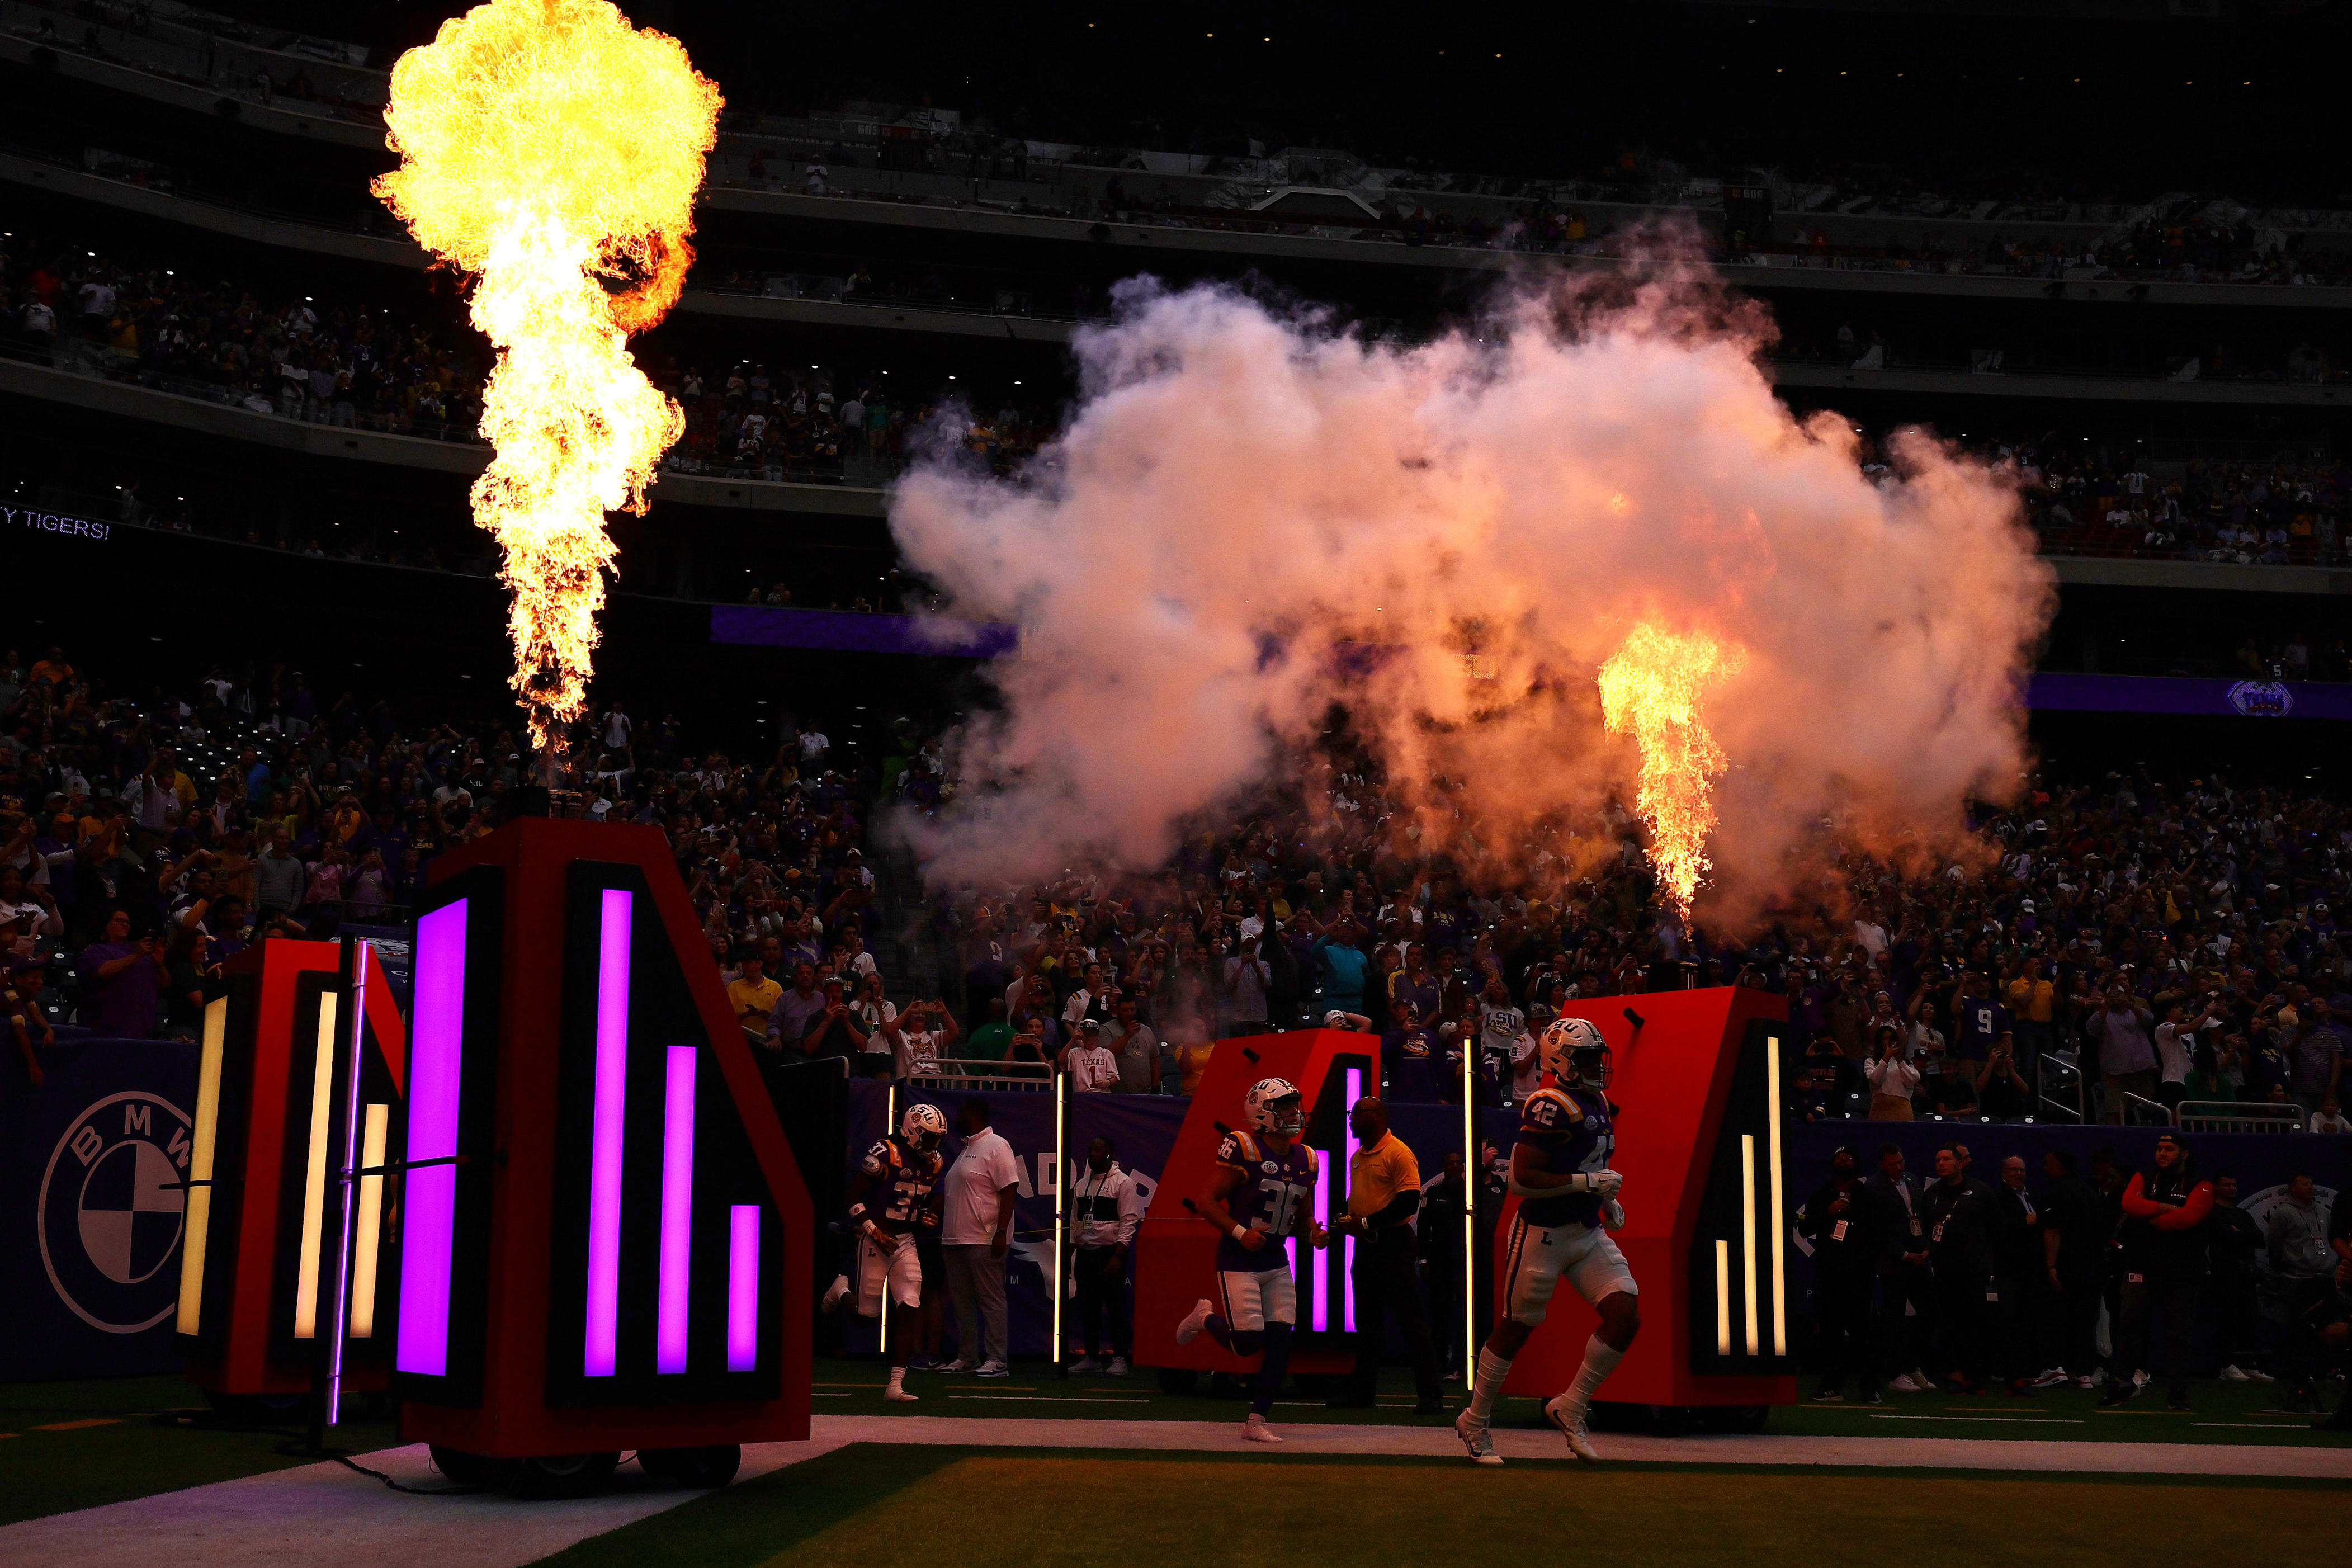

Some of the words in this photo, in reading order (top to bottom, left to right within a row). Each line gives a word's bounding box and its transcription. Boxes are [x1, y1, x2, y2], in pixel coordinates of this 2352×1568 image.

[0, 506, 17, 524] Y
[23, 510, 110, 541] TIGERS!
[2273, 664, 2282, 677] 5
[1485, 1012, 1517, 1029] LSU
[1978, 1008, 1992, 1034] 9
[1512, 1047, 1517, 1056] 9
[1088, 1066, 1098, 1088] 1
[1531, 1100, 1558, 1126] 42
[70, 1104, 193, 1170] BMW
[1217, 1136, 1237, 1159] 36
[868, 1141, 888, 1157] 37
[1250, 1178, 1307, 1235] 36
[1541, 1231, 1553, 1245] L
[868, 1247, 876, 1257] L
